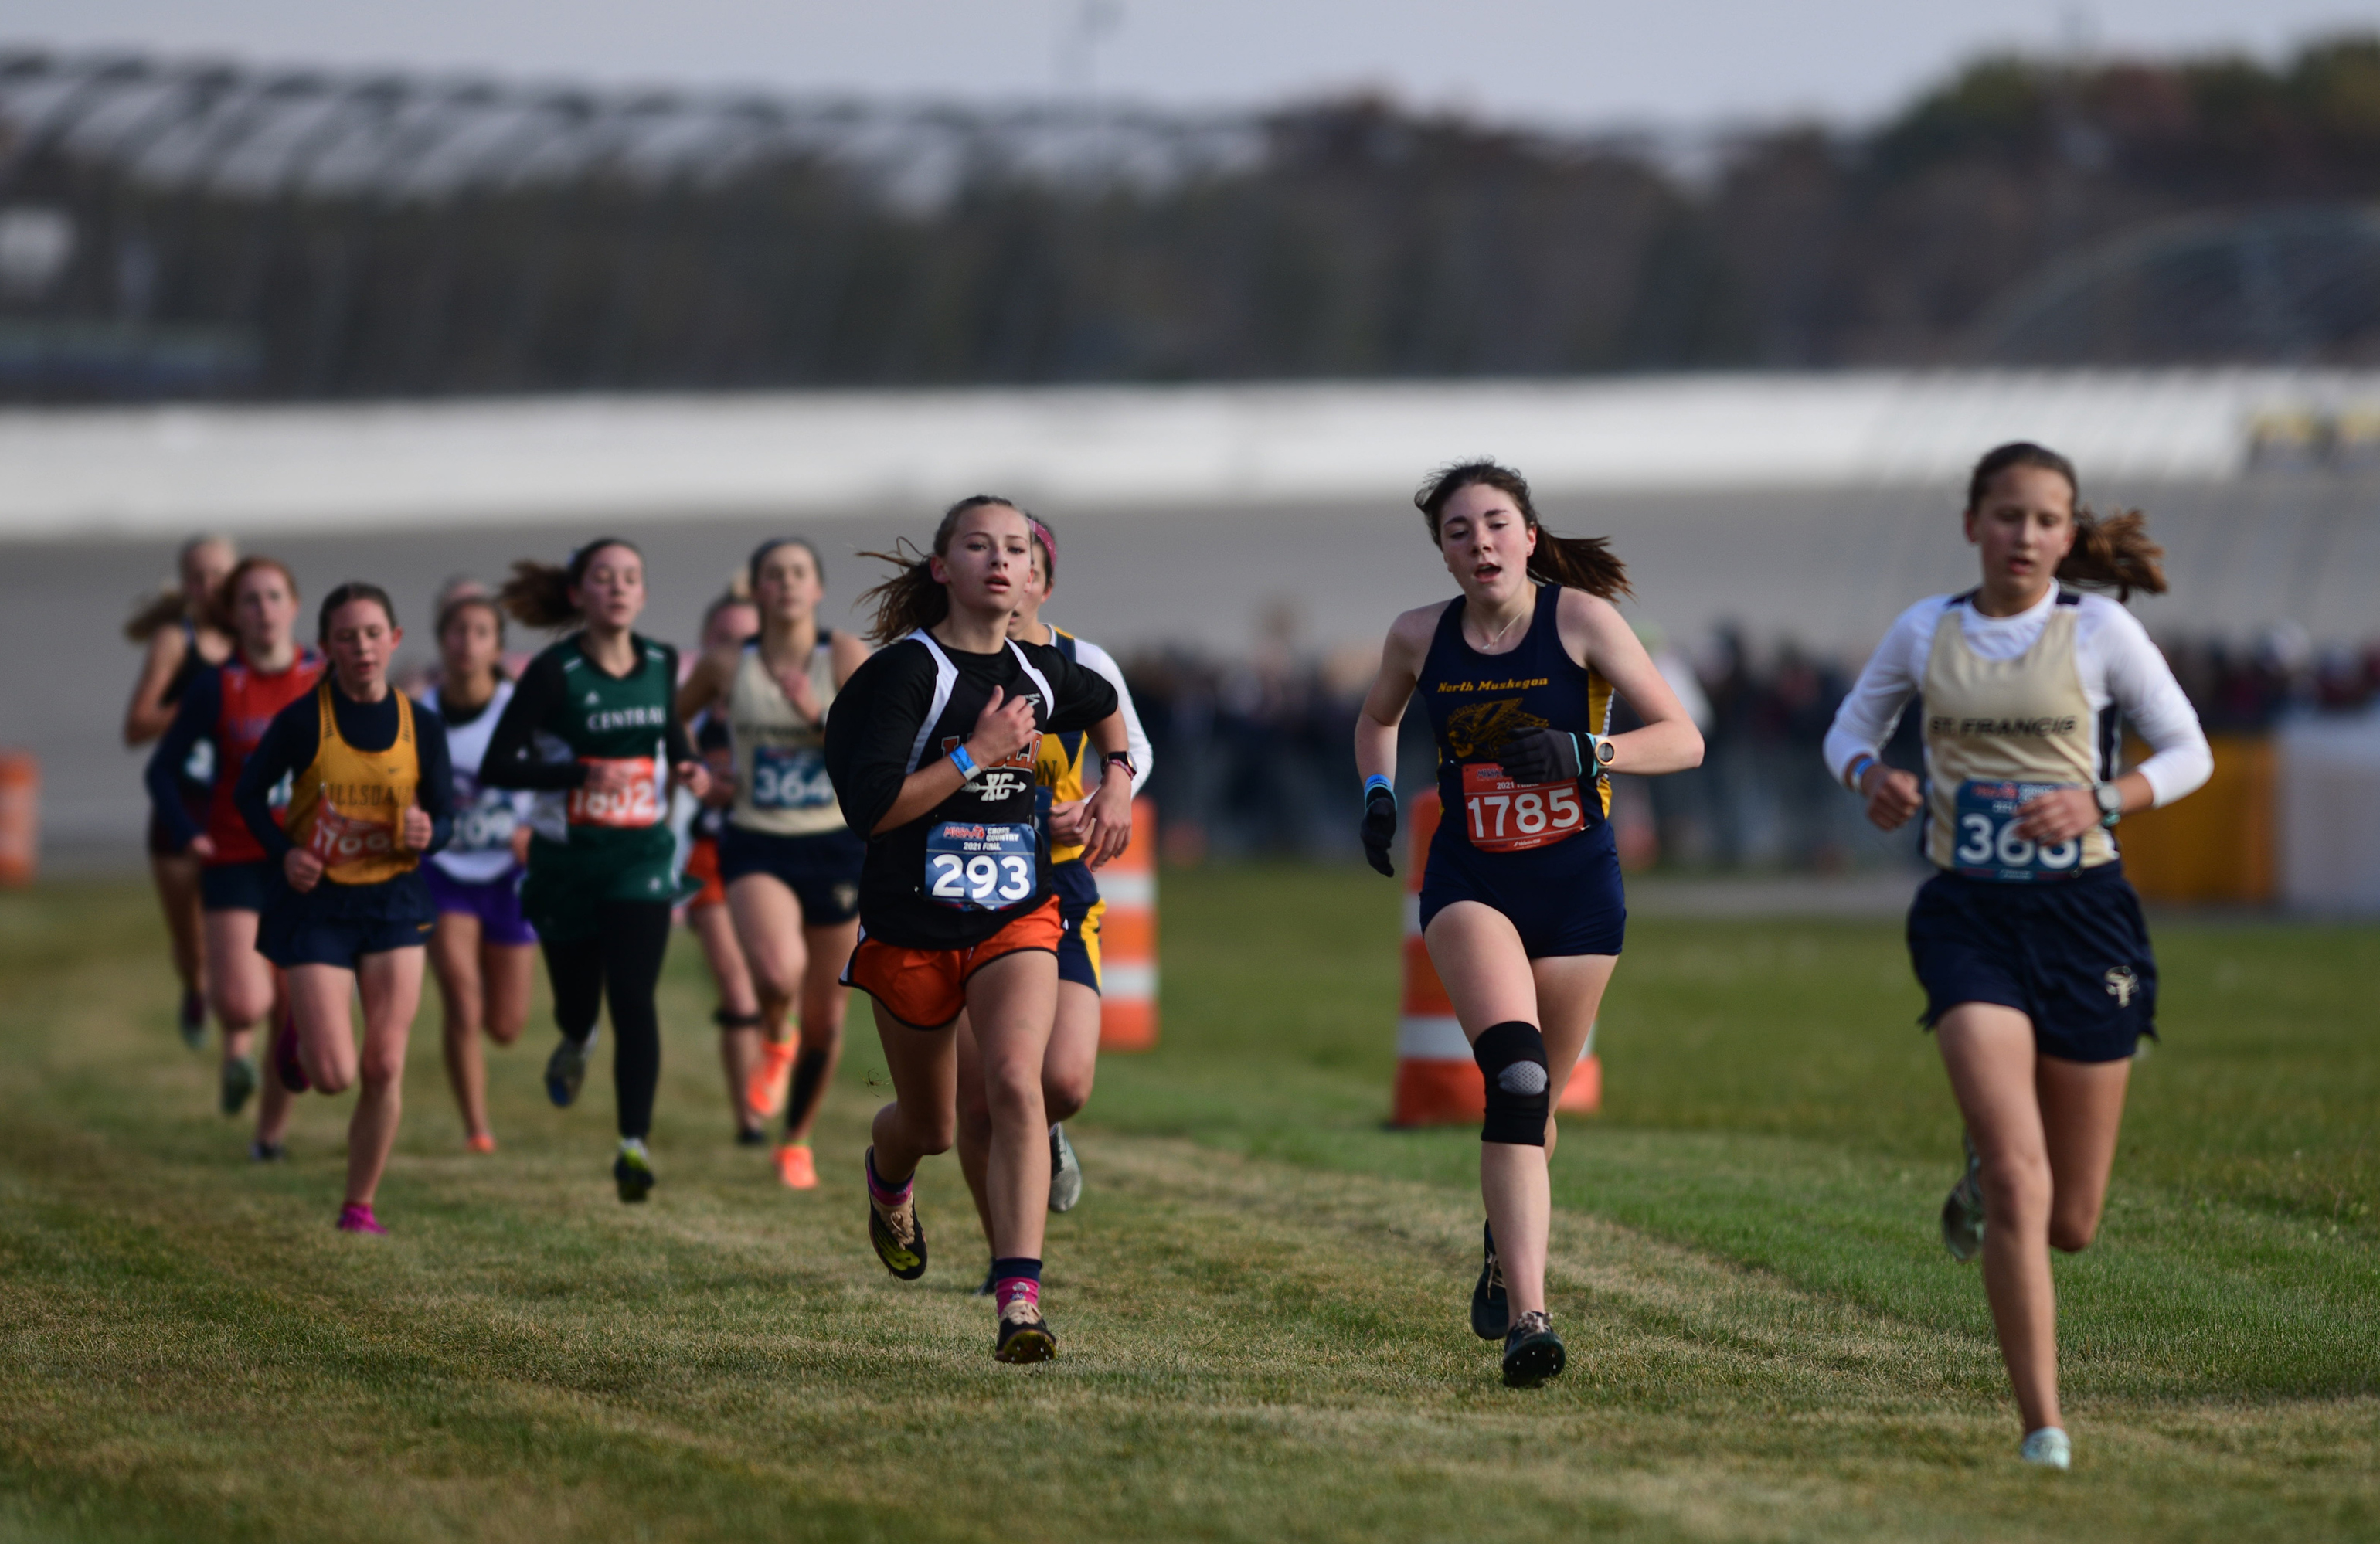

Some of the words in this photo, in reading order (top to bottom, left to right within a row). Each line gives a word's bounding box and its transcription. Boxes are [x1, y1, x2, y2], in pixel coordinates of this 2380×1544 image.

[1437, 682, 1474, 692] North
[1477, 678, 1548, 691] Muskegon
[756, 767, 831, 803] 364
[1497, 781, 1515, 790] 2021
[1468, 787, 1579, 838] 1785
[986, 833, 1019, 842] COUNTRY
[963, 842, 981, 851] 2021
[982, 842, 1001, 851] FINAL
[932, 853, 1031, 900] 293
